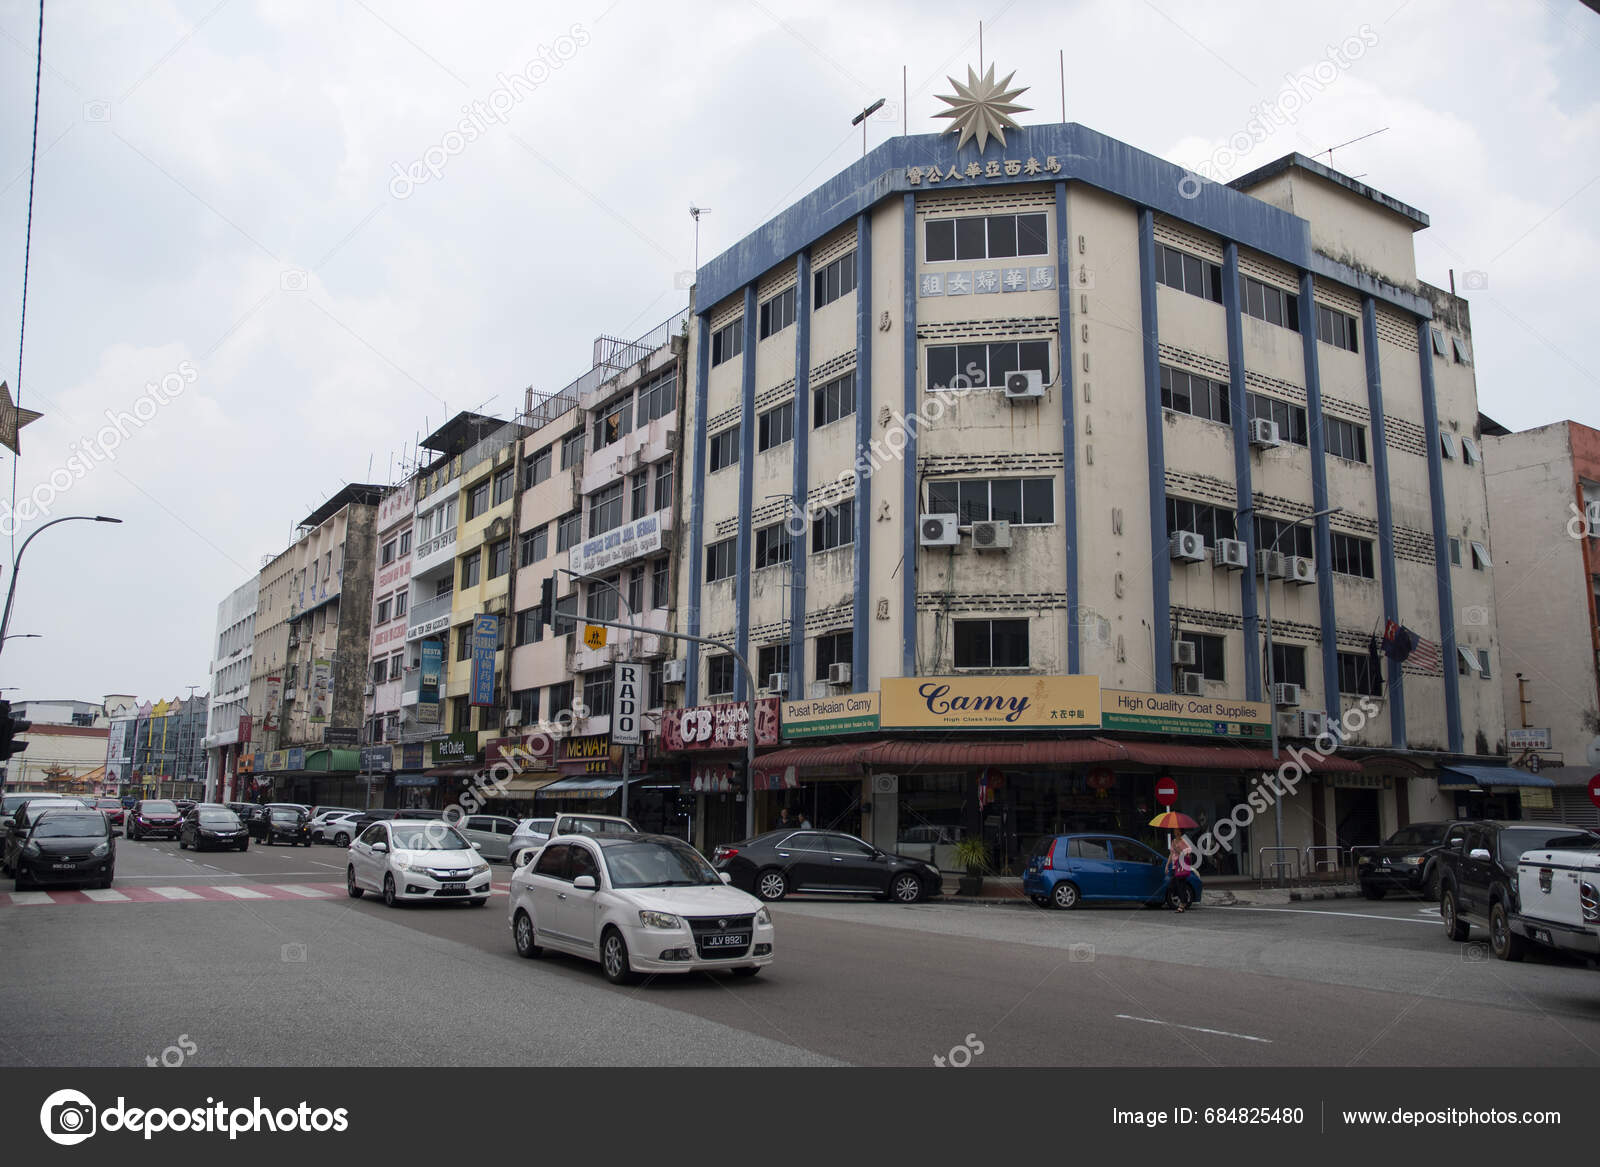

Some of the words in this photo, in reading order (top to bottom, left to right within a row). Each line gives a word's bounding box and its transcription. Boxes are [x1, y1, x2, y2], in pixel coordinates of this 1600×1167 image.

[620, 667, 636, 732] RADO
[788, 704, 811, 717] Pusat
[812, 700, 845, 715] Pakaian
[846, 698, 872, 712] Camy
[919, 683, 1031, 723] Camy
[1118, 696, 1143, 711] High
[1146, 698, 1185, 714] Quality
[1188, 701, 1213, 714] Coat
[1215, 704, 1257, 719] Supplies
[680, 710, 713, 743] CB
[715, 706, 749, 724] FASHION
[439, 742, 449, 755] Pet
[567, 736, 608, 759] MEWAH
[710, 936, 724, 946] JLV
[724, 935, 742, 945] 8921
